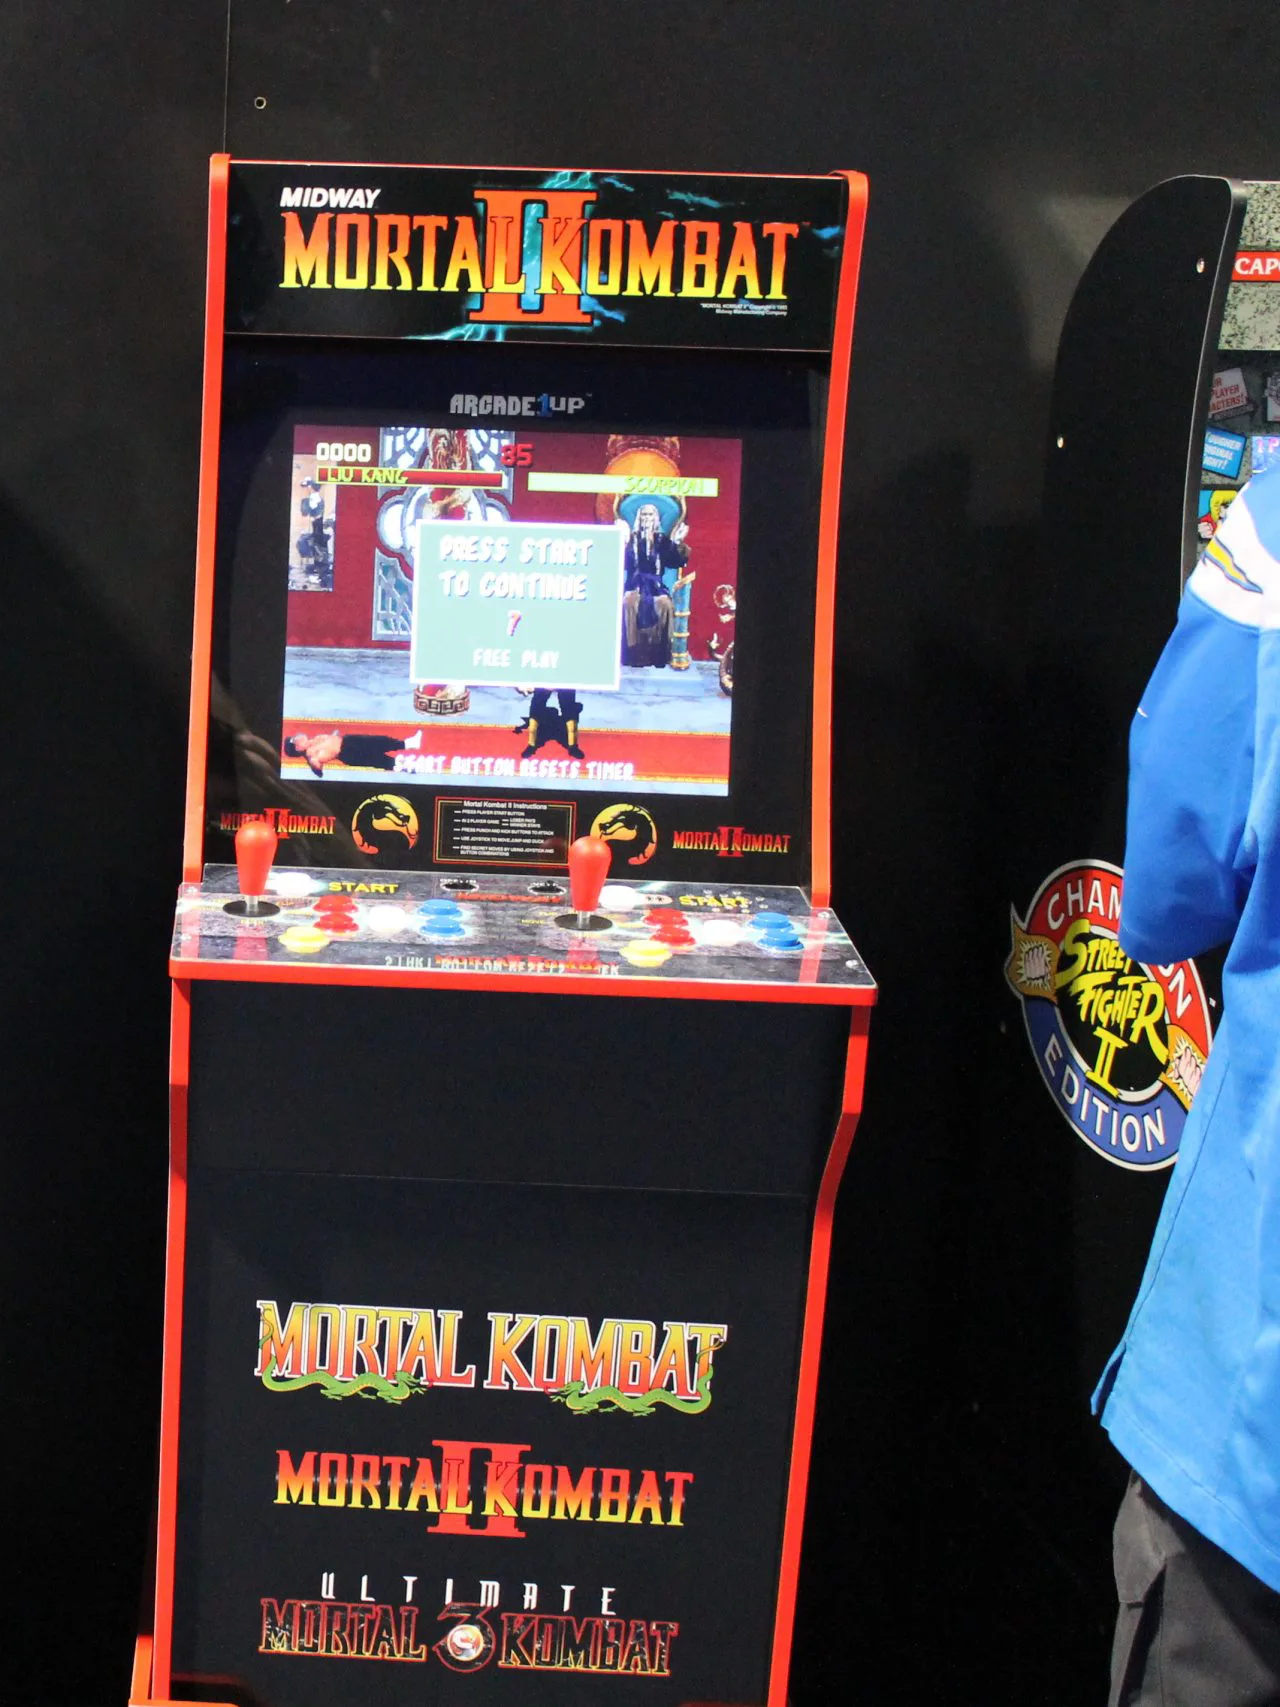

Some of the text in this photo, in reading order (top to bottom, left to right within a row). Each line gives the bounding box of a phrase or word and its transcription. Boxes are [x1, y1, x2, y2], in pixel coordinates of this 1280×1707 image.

[280, 187, 381, 208] MIDWAY
[278, 211, 527, 295] MORTAL
[534, 214, 800, 300] KOMBAT
[1234, 257, 1280, 275] CAP
[316, 442, 372, 463] 0000
[326, 467, 409, 485] LIU KANG
[622, 475, 706, 495] SCORPION
[439, 534, 593, 566] PRESS START
[438, 569, 588, 601] TO CONTINUE
[472, 648, 560, 669] FREE PLAY
[392, 754, 635, 781] START BUTTON RESETS TIMER
[463, 800, 481, 808] Mortal
[483, 801, 507, 809] Kombat
[513, 802, 548, 810] Instructions
[277, 815, 337, 835] KOMBAT
[672, 830, 729, 851] MORTAL
[731, 832, 792, 853] KOMBAT
[327, 881, 399, 894] START
[678, 894, 750, 907] START
[1054, 918, 1133, 988] STREET
[1068, 971, 1170, 1066] FIGHTER
[1045, 1033, 1166, 1153] EDITION
[255, 1299, 728, 1402] MORTAL KOMBAT
[273, 1449, 471, 1514] MORTAL
[480, 1460, 695, 1528] KOMBAT
[320, 1571, 617, 1617] ULTIMATE
[258, 1598, 680, 1677] MORTAL 3 KOMBAT
